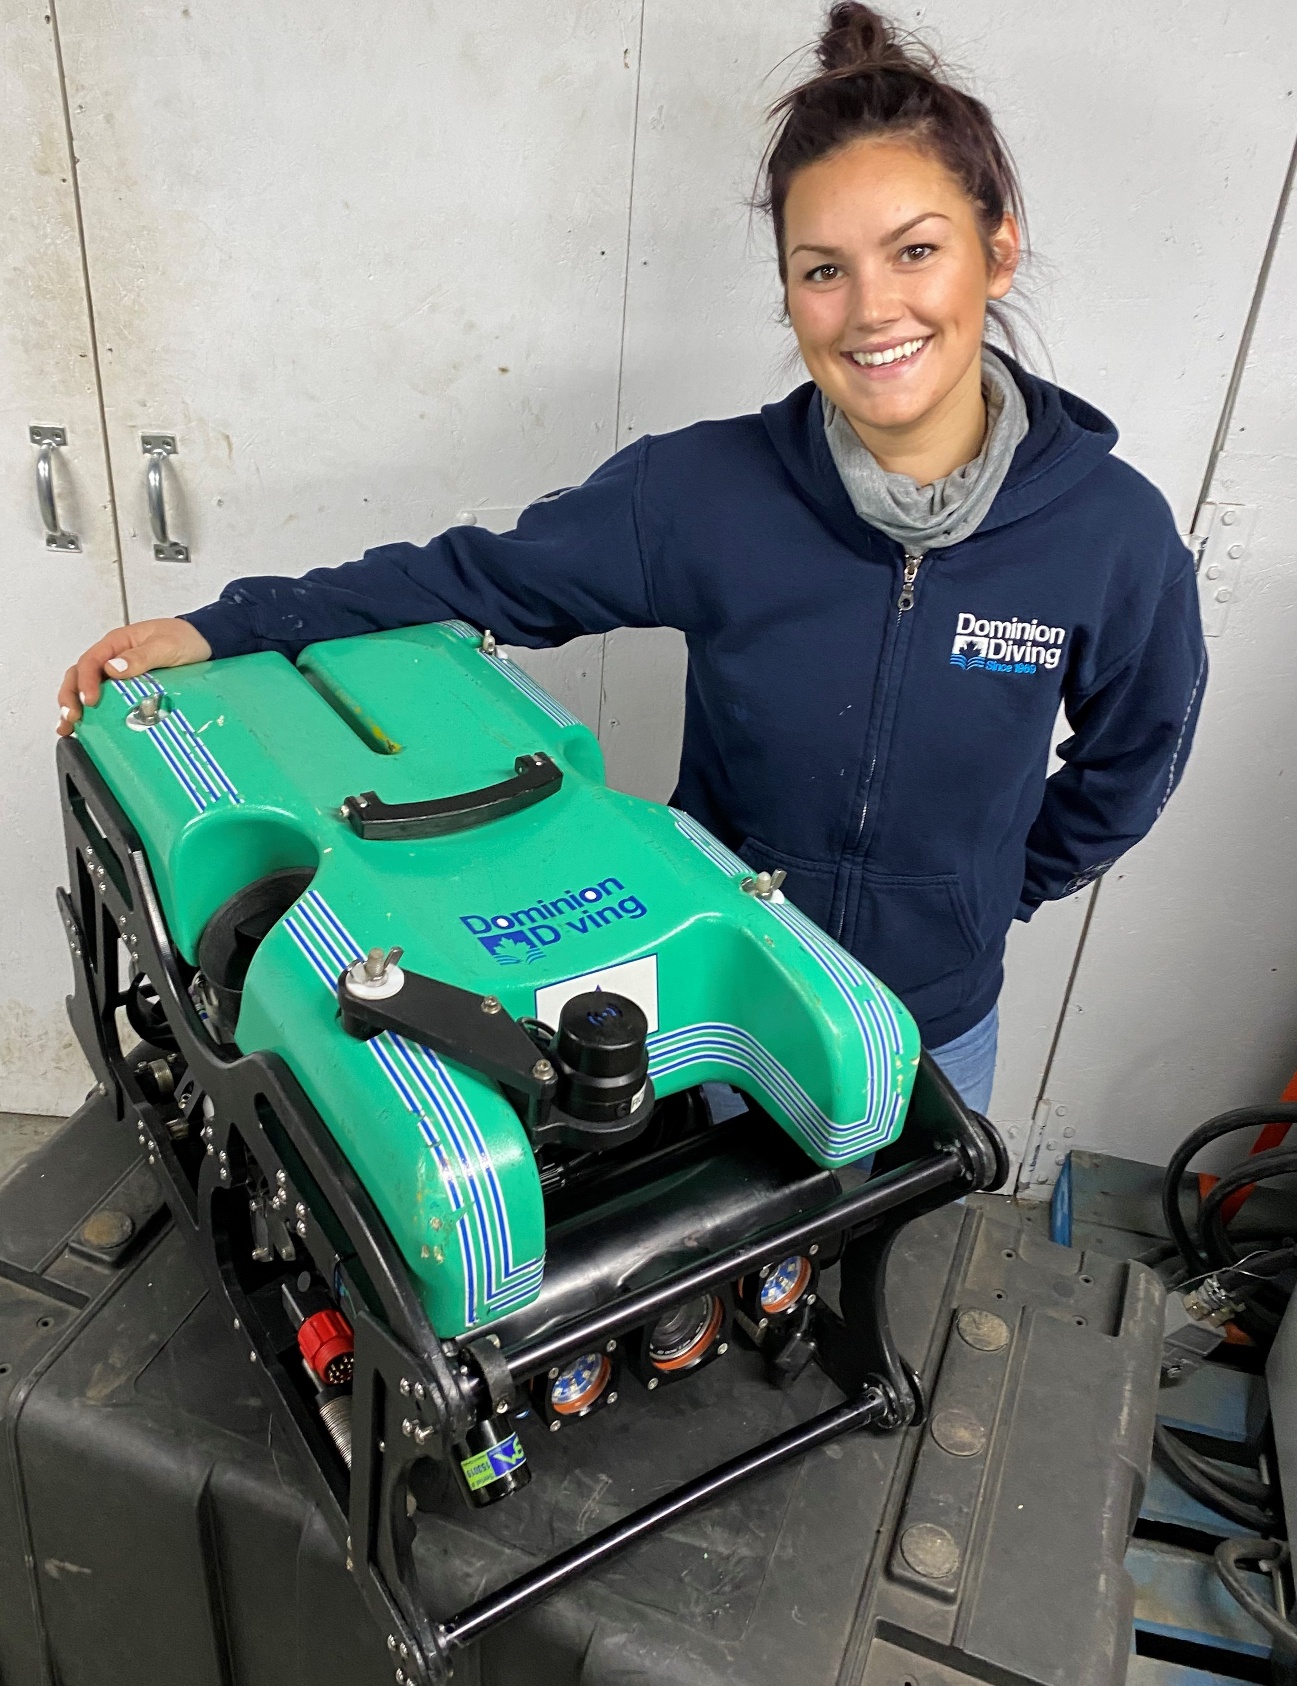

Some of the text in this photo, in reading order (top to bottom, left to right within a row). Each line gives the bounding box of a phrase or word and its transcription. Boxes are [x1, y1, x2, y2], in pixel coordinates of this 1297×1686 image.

[956, 612, 1066, 645] Dominion
[985, 660, 1013, 673] Since
[987, 638, 1062, 669] Diving
[459, 877, 625, 935] Dominion
[528, 895, 648, 946] Dving
